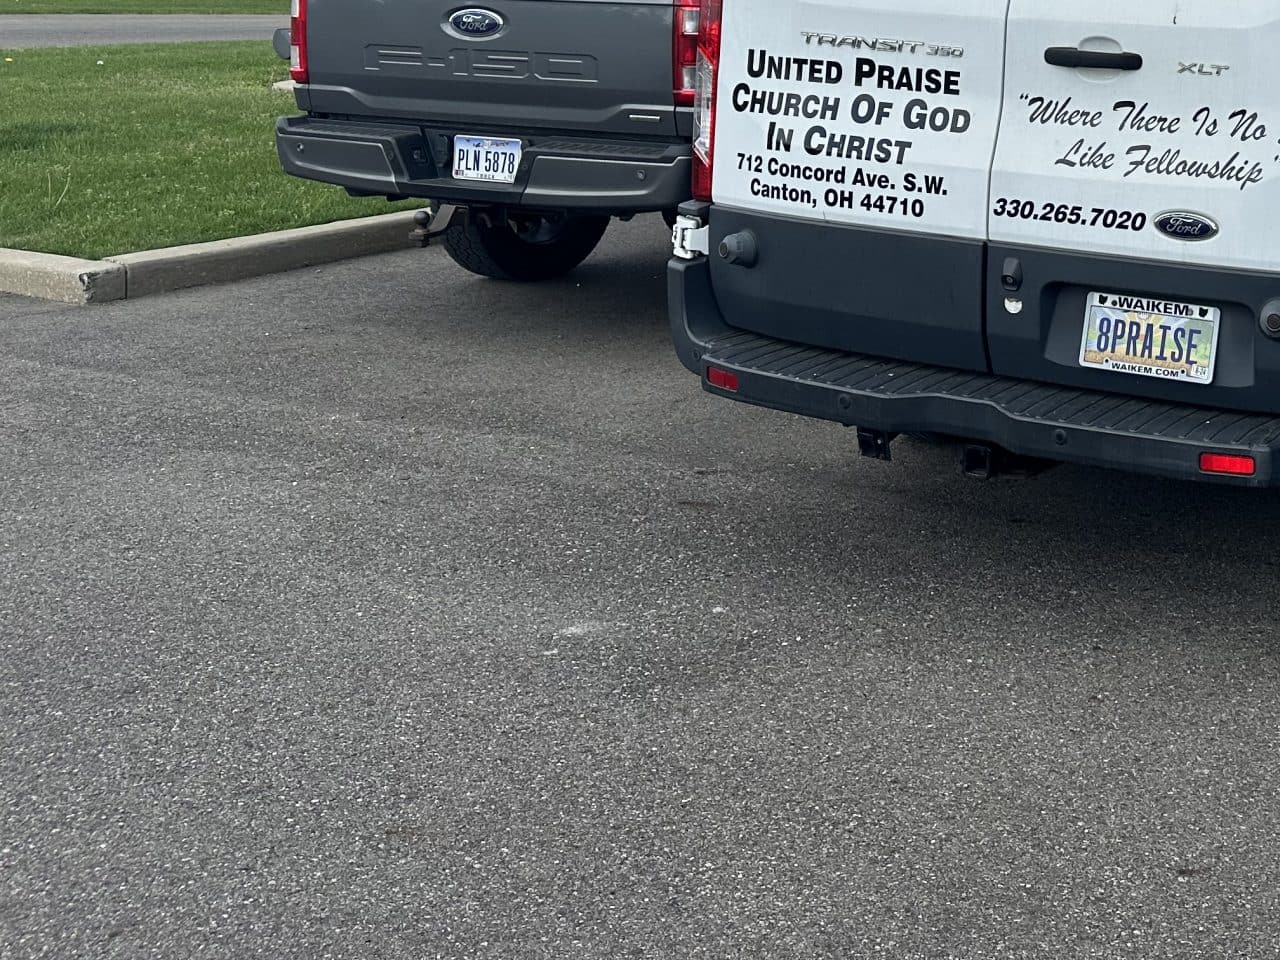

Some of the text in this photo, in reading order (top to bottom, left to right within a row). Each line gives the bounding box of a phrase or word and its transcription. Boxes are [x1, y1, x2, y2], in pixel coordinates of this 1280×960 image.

[460, 14, 489, 31] Ford
[363, 43, 599, 83] F-150
[801, 32, 924, 55] TRANSIT
[747, 49, 961, 95] UNITED PRAISE
[1177, 62, 1230, 76] XLT
[732, 82, 971, 133] CHURCH OF GOD
[1113, 100, 1181, 133] There
[1192, 106, 1218, 136] Is
[1228, 109, 1266, 141] No
[457, 148, 515, 174] PLN 5878
[766, 121, 912, 165] IN CHRIST
[1055, 138, 1115, 169] Like
[737, 153, 948, 195] 712 Concord Ave. S.W.
[750, 178, 924, 218] Canton, OH 44710
[993, 197, 1201, 235] 330.265.7020 Ford
[1117, 296, 1189, 316] WAIKEM
[1097, 317, 1201, 365] 8PRAISE
[1111, 361, 1179, 377] WAIKEM.COM
